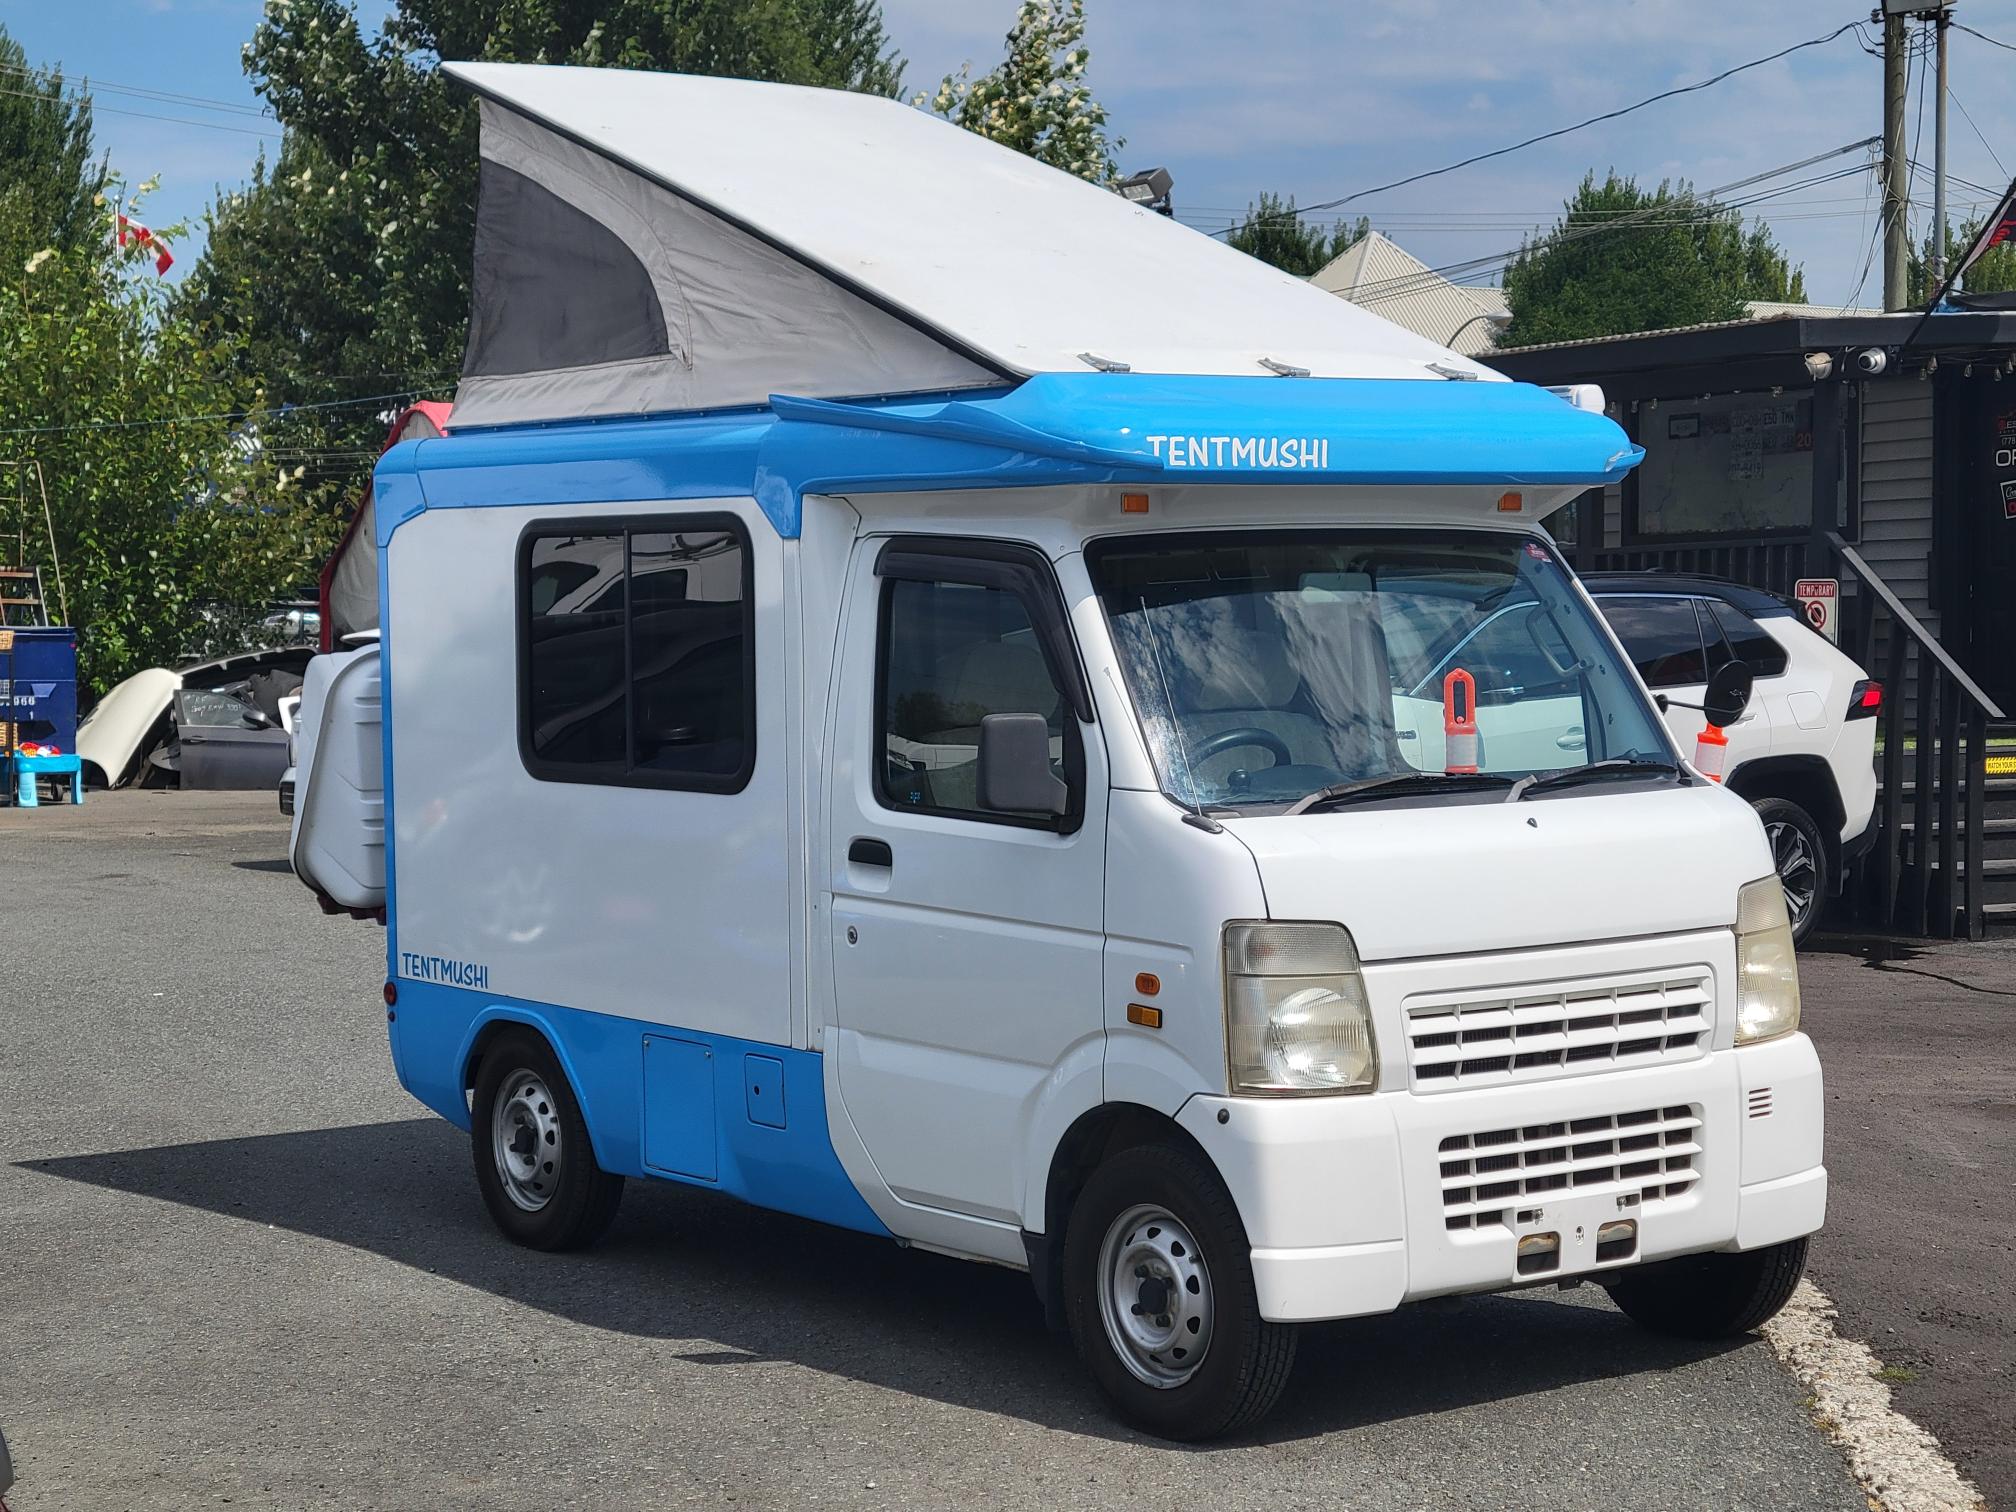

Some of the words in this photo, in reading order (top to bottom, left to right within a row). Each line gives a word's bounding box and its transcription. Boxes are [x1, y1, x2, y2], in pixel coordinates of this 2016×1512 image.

[1146, 435, 1328, 468] TENTMUSHI
[1800, 584, 1834, 596] TEMPORARY
[402, 952, 488, 990] TENTMUSHI
